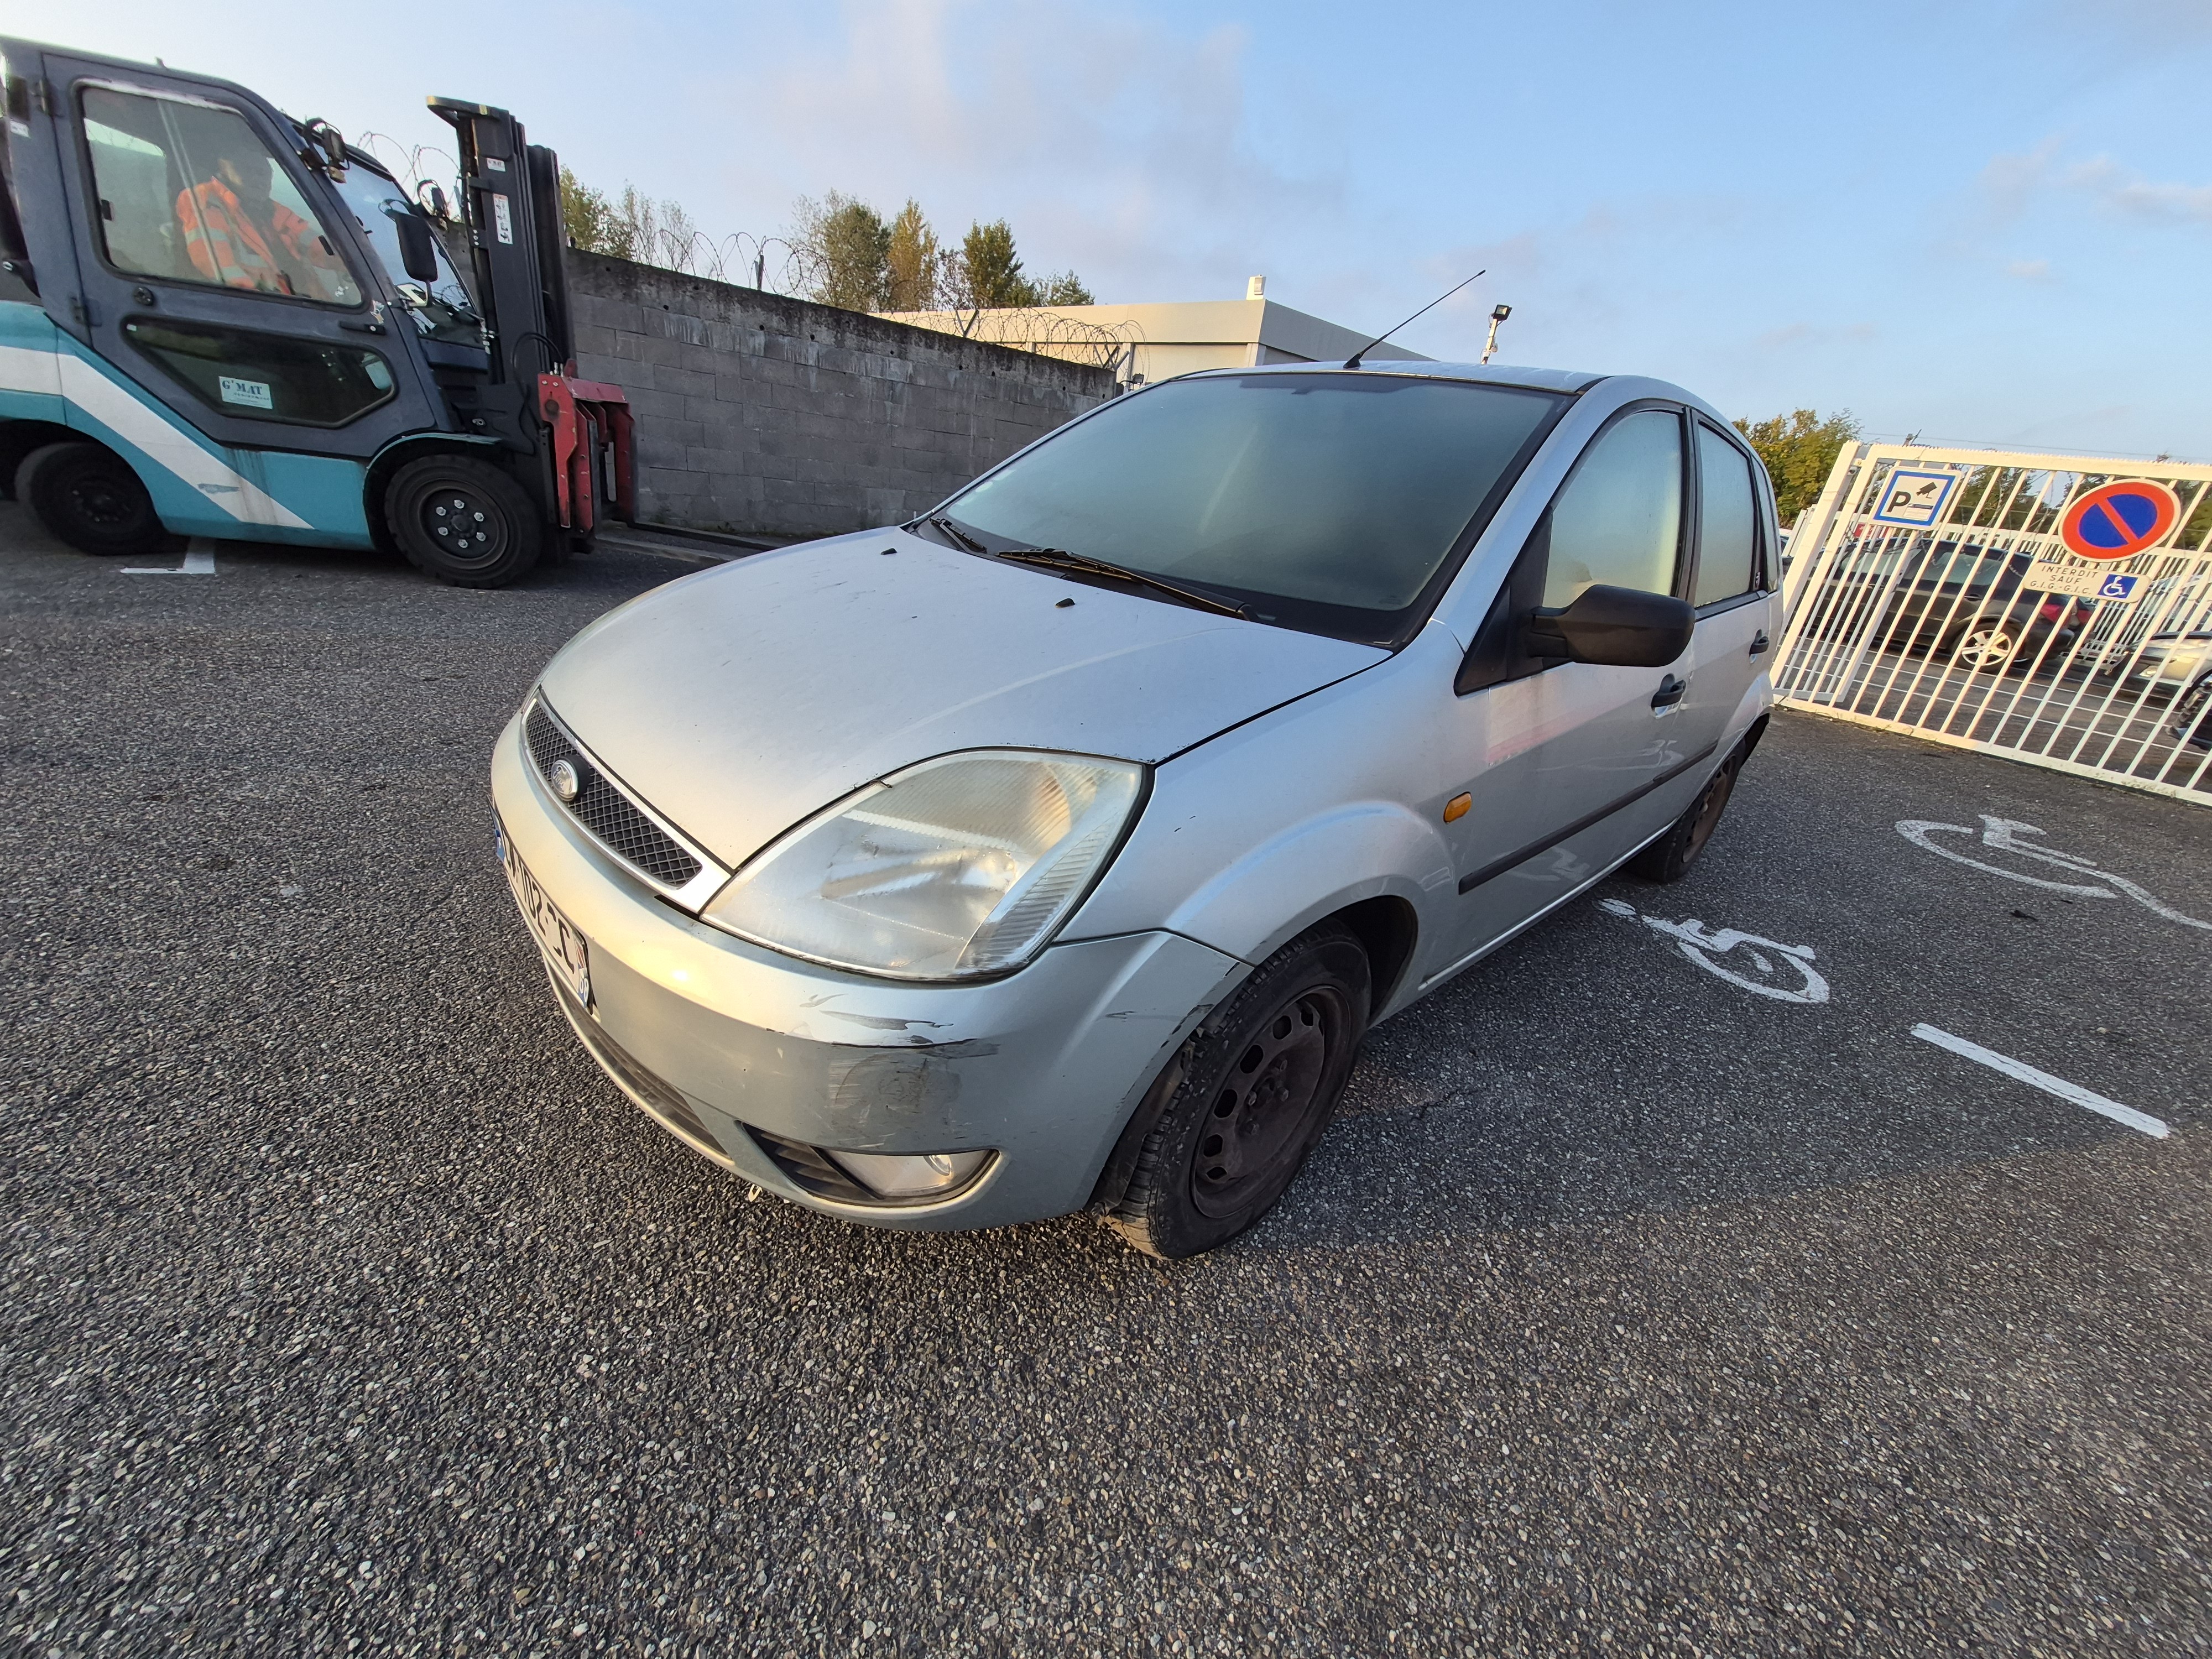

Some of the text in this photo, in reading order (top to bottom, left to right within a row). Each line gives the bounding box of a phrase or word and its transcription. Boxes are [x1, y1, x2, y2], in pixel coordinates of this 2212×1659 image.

[1886, 491, 1911, 513] P
[2042, 566, 2098, 578] INTERDIT
[2050, 575, 2082, 583] SAUF
